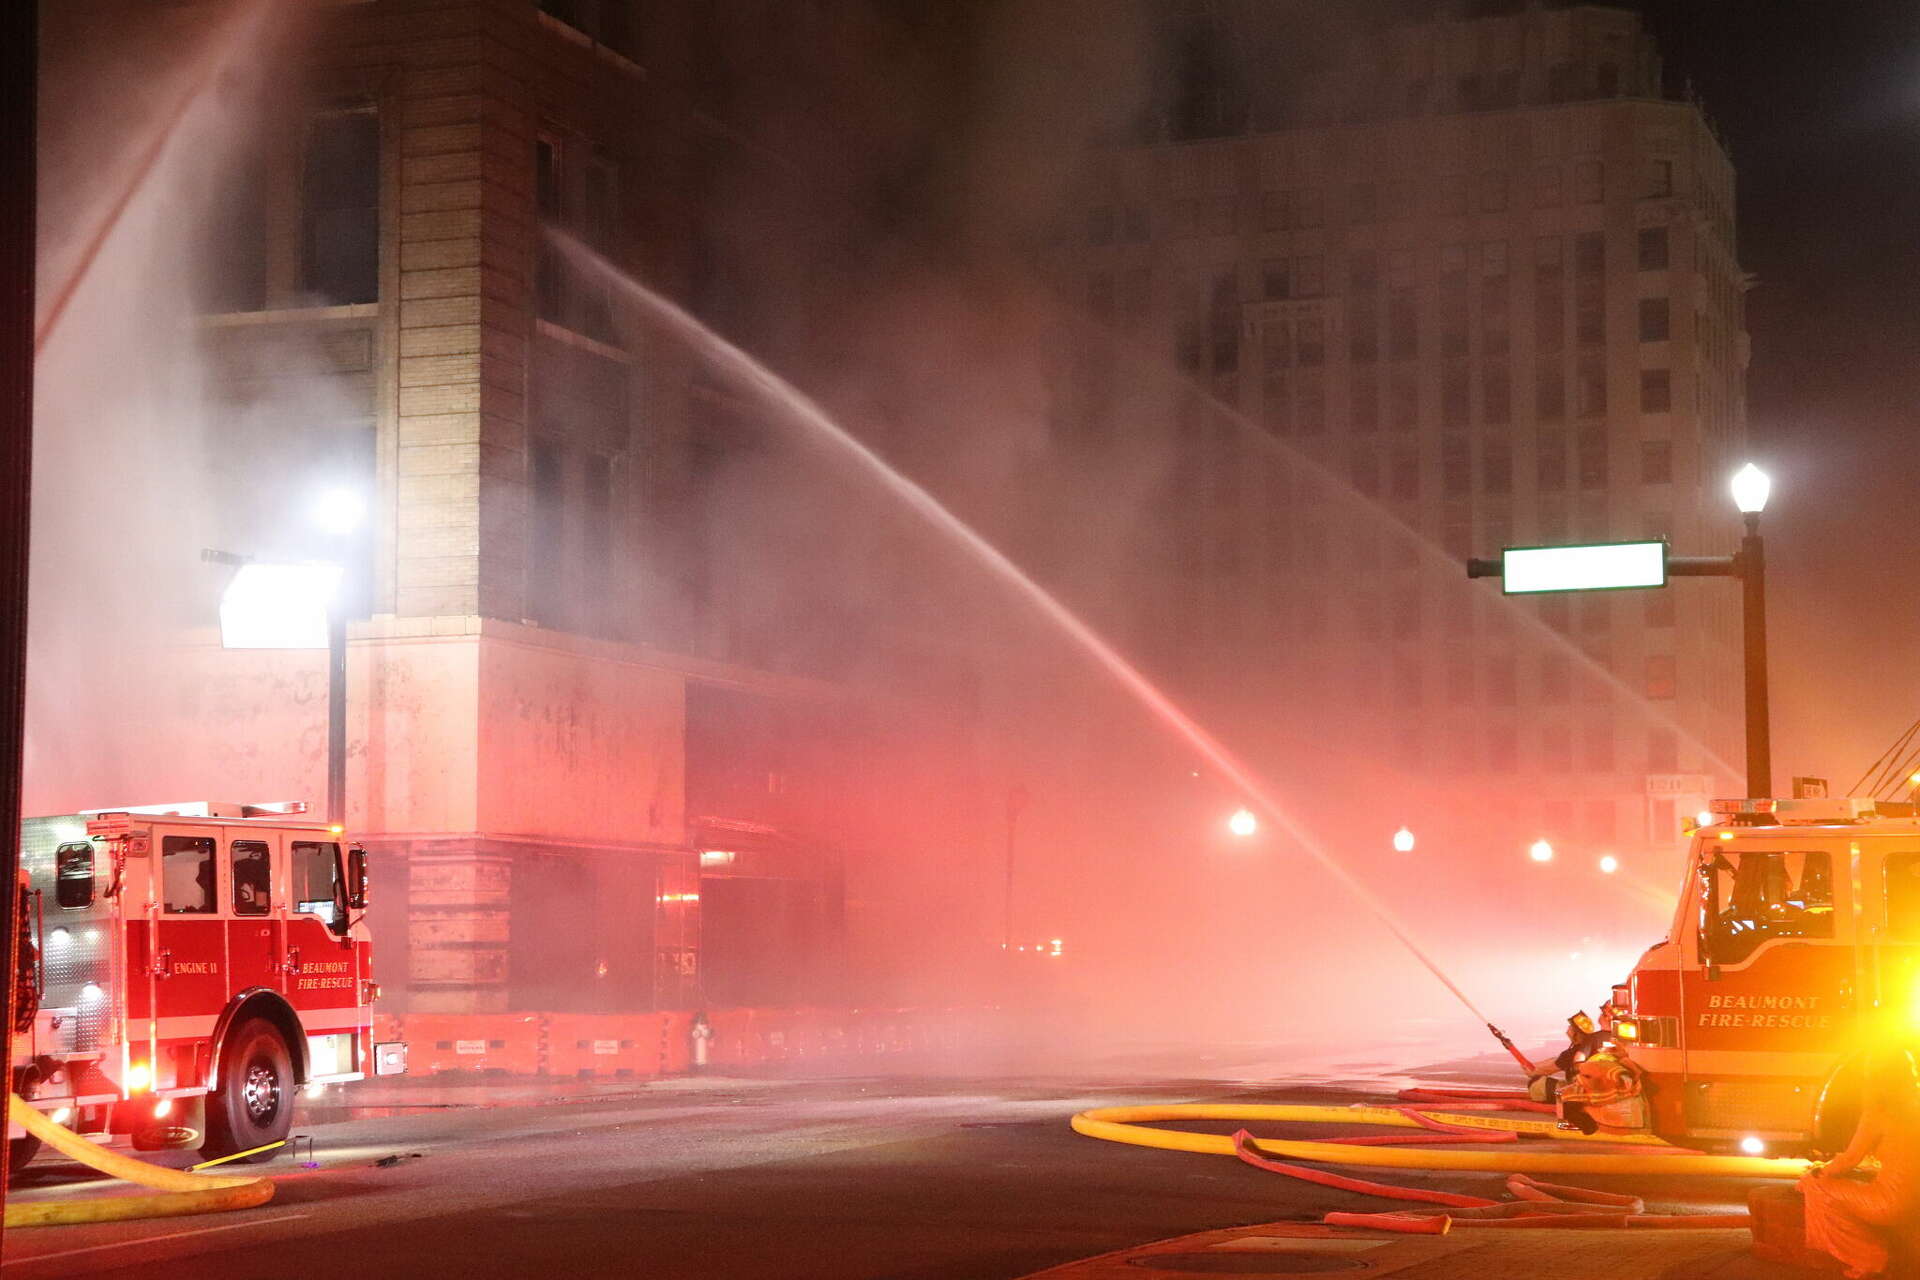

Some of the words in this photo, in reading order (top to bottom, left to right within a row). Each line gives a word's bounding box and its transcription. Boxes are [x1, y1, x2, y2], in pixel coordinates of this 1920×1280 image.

[174, 962, 208, 975] ENGINE
[302, 962, 349, 974] BEAUMONT
[297, 977, 353, 990] FIRE-RESCUE
[1708, 995, 1821, 1009] BEAUMONT
[1698, 1013, 1831, 1028] FIRE-RESCUE
